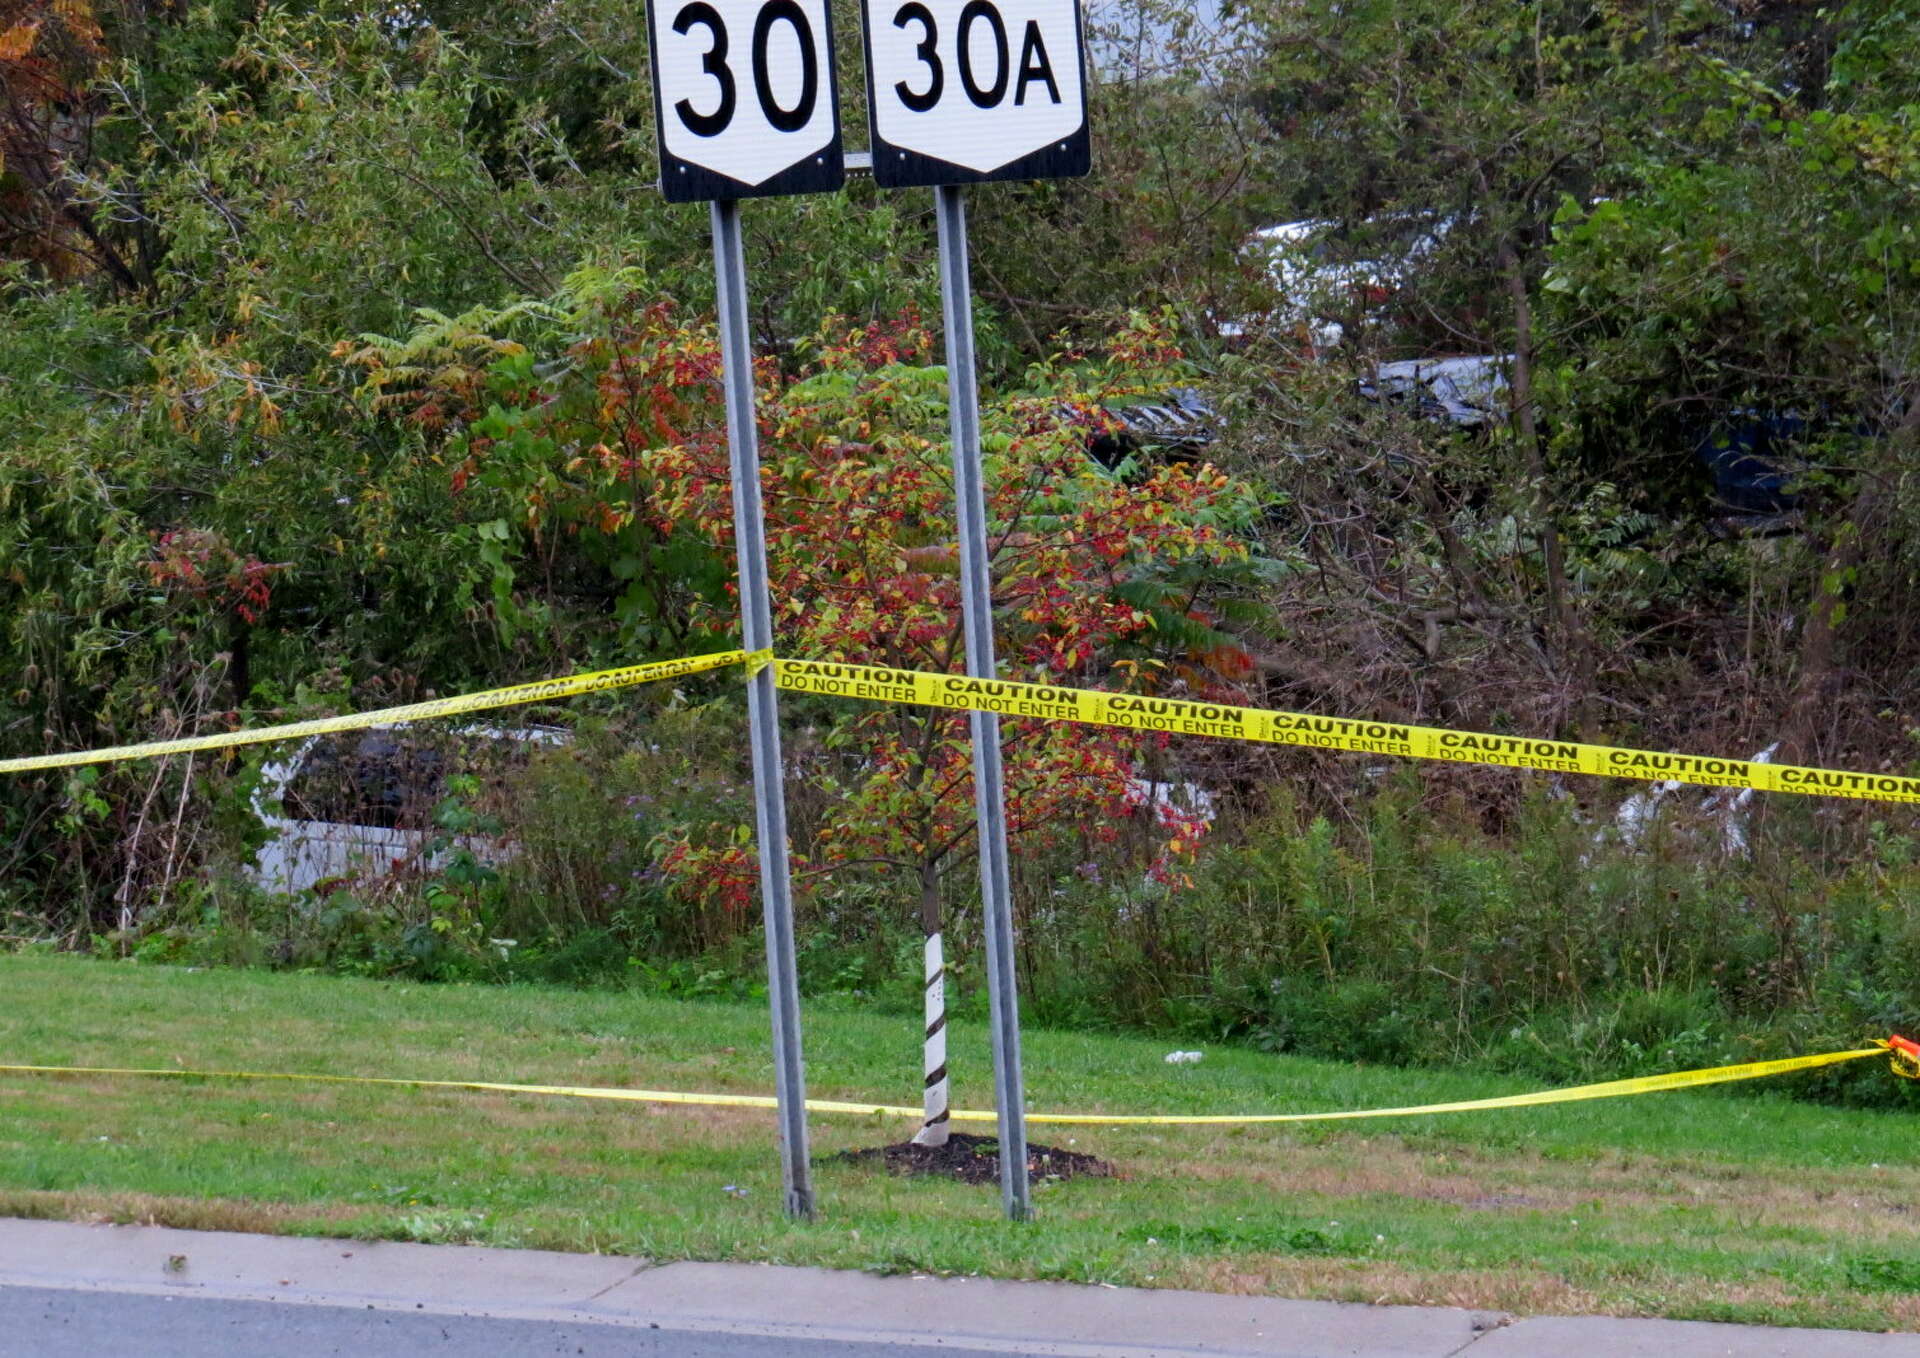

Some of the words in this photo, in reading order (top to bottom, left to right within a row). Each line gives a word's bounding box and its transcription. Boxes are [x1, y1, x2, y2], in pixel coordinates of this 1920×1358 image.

[672, 0, 818, 137] 30
[893, 0, 1061, 112] 30A
[783, 662, 915, 685] CAUTION
[782, 674, 807, 689] DO
[813, 678, 850, 693] NOT
[856, 683, 916, 701] ENTER
[945, 678, 1078, 704] CAUTION
[944, 694, 969, 706] DO
[976, 697, 1012, 712] NOT
[1019, 702, 1079, 719] ENTER
[1108, 697, 1242, 722] CAUTION
[1107, 712, 1133, 725] DO
[1139, 715, 1176, 729] NOT
[1183, 720, 1245, 737] ENTER
[1273, 715, 1409, 741] CAUTION
[1272, 730, 1299, 743] DO
[1305, 734, 1342, 747] NOT
[1350, 739, 1411, 754] ENTER
[1440, 733, 1578, 759] CAUTION
[1440, 748, 1466, 760] DO
[1473, 752, 1510, 764] NOT
[1518, 757, 1580, 771] ENTER
[1609, 751, 1749, 776] CAUTION
[1609, 766, 1636, 777] DO
[1643, 770, 1680, 780] NOT
[1780, 769, 1920, 794] CAUTION
